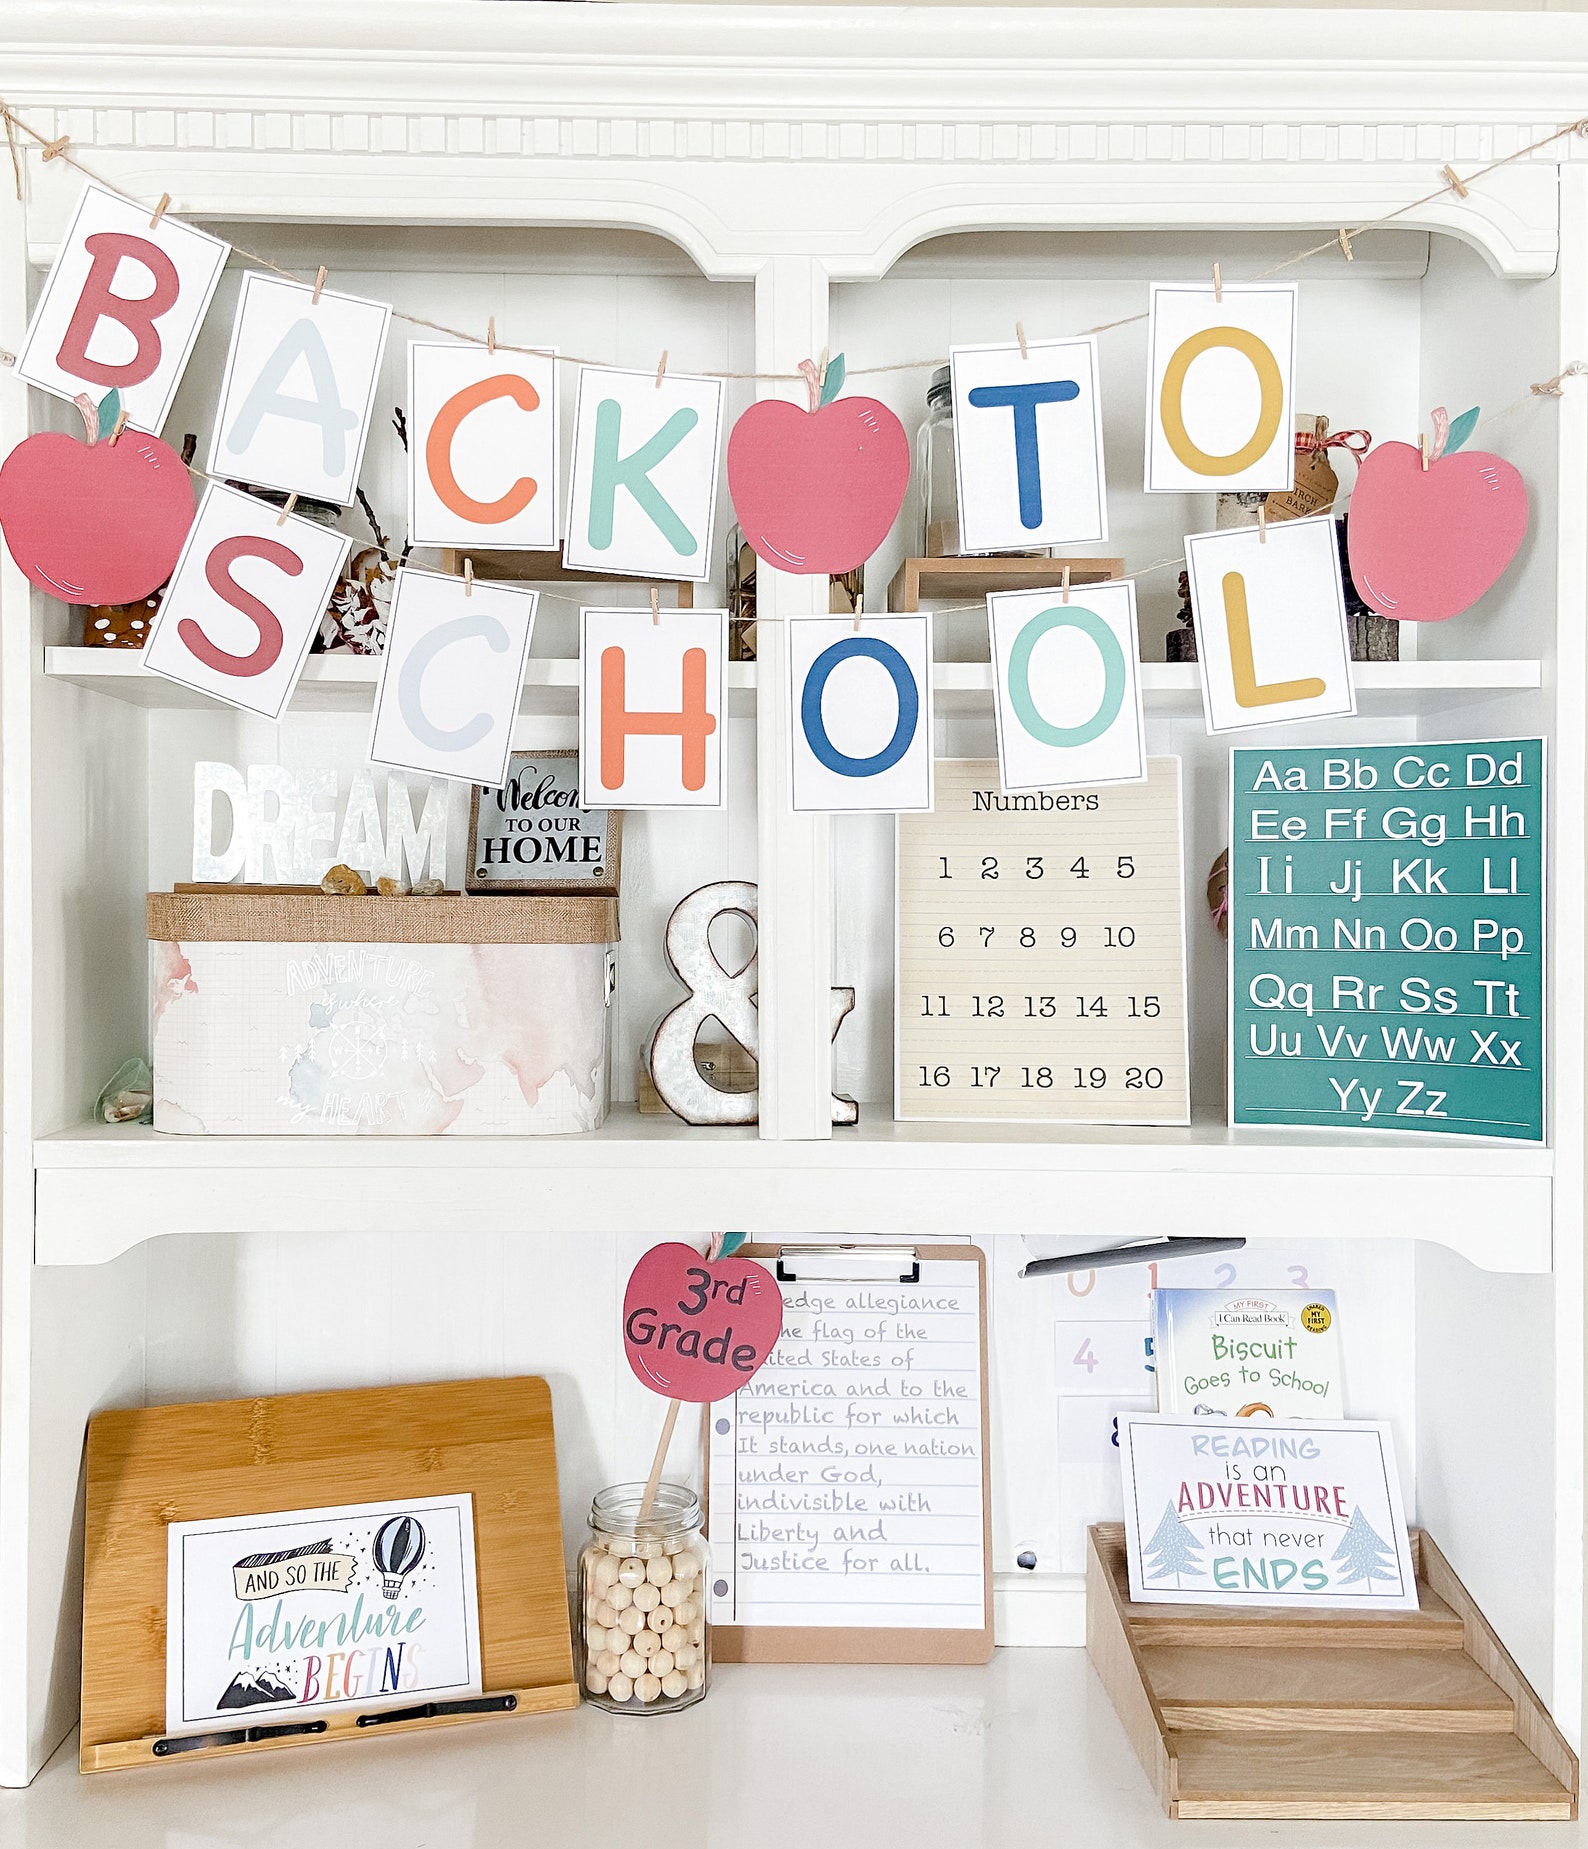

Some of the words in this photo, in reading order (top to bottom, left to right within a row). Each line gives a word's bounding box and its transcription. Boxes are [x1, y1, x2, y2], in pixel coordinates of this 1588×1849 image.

[1286, 496, 1312, 514] BARK
[1293, 487, 1318, 506] IRCH
[1252, 760, 1308, 791] Aa
[1323, 757, 1378, 790] Bb
[1392, 755, 1450, 788] Cc
[1466, 751, 1522, 787] Dd
[972, 791, 1099, 811] Numbers
[192, 761, 449, 887] DREAM
[505, 818, 533, 832] TO
[538, 818, 581, 832] OUR
[1251, 809, 1307, 840] Ee
[1325, 807, 1367, 839] Ff
[1381, 806, 1447, 847] Gg
[1465, 805, 1525, 837] Hh
[482, 836, 602, 864] HOME
[939, 857, 953, 879] 1
[981, 857, 999, 879] 2
[1026, 857, 1044, 879] 3
[1070, 856, 1089, 878] 4
[1117, 856, 1135, 879] 5
[1330, 860, 1362, 902] Jj
[1392, 858, 1448, 894] Kk
[1483, 857, 1518, 894] Ll
[938, 926, 955, 947] 6
[979, 927, 995, 947] 7
[1019, 927, 1036, 947] 8
[1060, 927, 1077, 947] 9
[1104, 926, 1135, 947] 10
[1251, 918, 1318, 949] Mm
[1334, 918, 1386, 950] Nn
[1400, 917, 1457, 951] Oo
[1473, 919, 1524, 960] Pp
[286, 949, 435, 998] ADVENTURE
[322, 992, 336, 1015] is
[337, 988, 399, 1011] where
[921, 995, 950, 1016] 11
[972, 996, 1005, 1017] 12
[1024, 996, 1056, 1017] 13
[1076, 996, 1108, 1017] 14
[1127, 996, 1161, 1017] 15
[1248, 973, 1313, 1017] Qq
[1332, 975, 1384, 1010] Rr
[1399, 977, 1458, 1014] Ss
[1473, 980, 1520, 1017] Tt
[1250, 1024, 1301, 1056] Uu
[1317, 1025, 1368, 1057] Vv
[1381, 1027, 1456, 1061] Ww
[1470, 1030, 1522, 1066] Xx
[919, 1066, 950, 1087] 16
[970, 1066, 1001, 1087] 17
[1021, 1067, 1053, 1088] 18
[1073, 1067, 1106, 1088] 19
[1125, 1067, 1163, 1088] 20
[275, 1095, 317, 1124] my
[319, 1090, 408, 1126] HEART
[1329, 1078, 1382, 1121] Yy
[1396, 1081, 1448, 1117] Zz
[677, 1268, 747, 1316] 3rd
[845, 1292, 960, 1315] allegiance
[1233, 1300, 1246, 1310] MY
[1247, 1300, 1269, 1310] FIRST
[780, 1321, 803, 1338] he
[813, 1319, 854, 1345] flag
[864, 1323, 888, 1342] of
[897, 1323, 928, 1340] the
[1224, 1314, 1241, 1323] Can
[1243, 1314, 1262, 1323] Read
[1264, 1314, 1285, 1323] Book
[626, 1308, 756, 1372] Grade
[1211, 1334, 1298, 1361] Biscuit
[821, 1349, 881, 1367] States
[891, 1348, 914, 1368] of
[1073, 1337, 1099, 1374] 4
[739, 1380, 837, 1397] America
[846, 1379, 889, 1397] and
[900, 1379, 922, 1398] to
[933, 1379, 968, 1398] the
[1184, 1372, 1230, 1396] Goes
[1238, 1365, 1261, 1384] to
[1268, 1368, 1330, 1398] School
[738, 1402, 834, 1434] republic
[845, 1402, 881, 1429] for
[893, 1406, 959, 1426] which
[738, 1437, 759, 1454] It
[769, 1436, 848, 1459] stands,
[855, 1443, 898, 1457] one
[904, 1439, 975, 1457] nation
[1191, 1435, 1320, 1461] READING
[739, 1463, 808, 1484] under
[820, 1465, 882, 1487] God,
[1225, 1461, 1241, 1480] is
[1253, 1464, 1286, 1482] an
[738, 1489, 868, 1512] indivisible
[880, 1493, 931, 1513] with
[1177, 1481, 1350, 1518] ADVENTURE
[737, 1521, 819, 1551] Liberty
[834, 1523, 887, 1542] and
[1209, 1522, 1253, 1547] that
[1264, 1530, 1324, 1548] never
[741, 1549, 829, 1572] Justice
[842, 1550, 879, 1576] for
[890, 1552, 930, 1573] all.
[1213, 1556, 1329, 1591] ENDS
[245, 1569, 279, 1594] AND
[286, 1564, 306, 1586] SO
[313, 1561, 341, 1582] THE
[228, 1593, 427, 1661] Adventure
[297, 1642, 426, 1704] BEGINS
